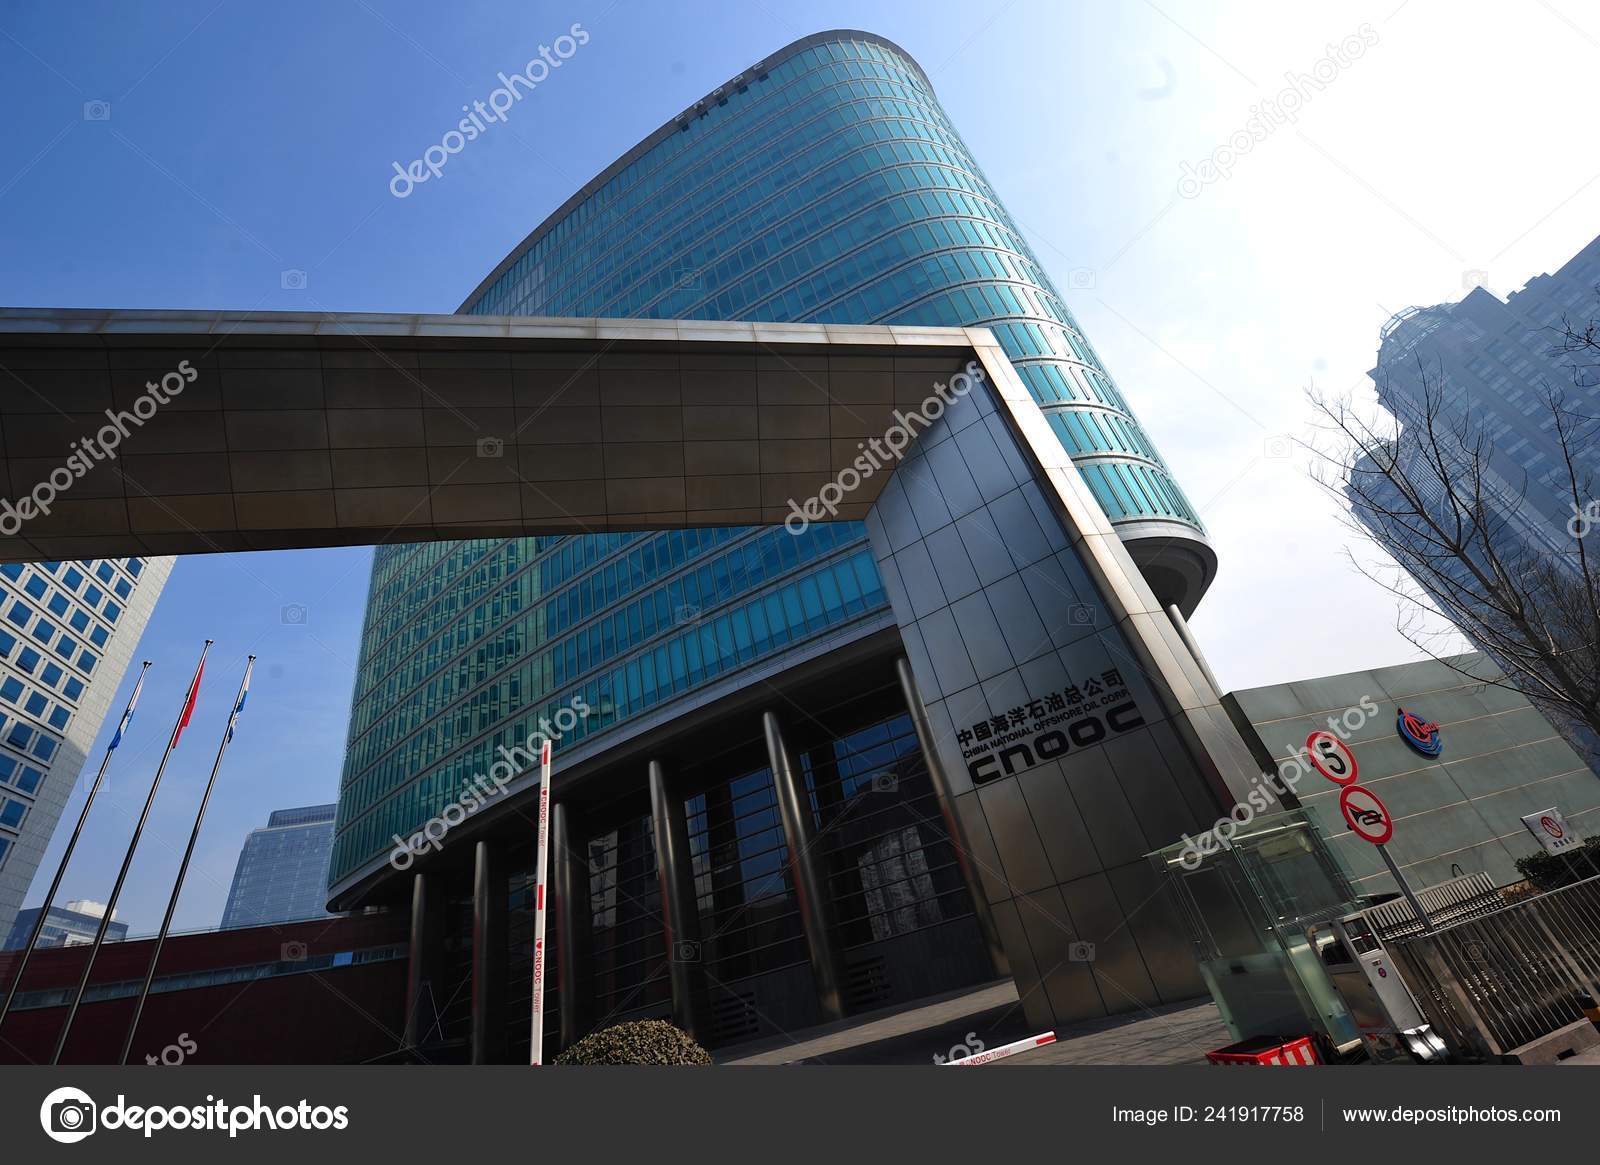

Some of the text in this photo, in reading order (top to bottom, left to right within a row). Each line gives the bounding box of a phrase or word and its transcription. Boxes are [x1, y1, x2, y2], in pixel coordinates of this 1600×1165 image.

[957, 668, 1125, 747] 中国海洋石油总公司
[963, 743, 990, 759] CHINA
[991, 727, 1033, 748] NATIONAL
[1034, 706, 1083, 731] OFFSHORE
[1083, 701, 1100, 713] OIL
[1319, 741, 1346, 774] 5
